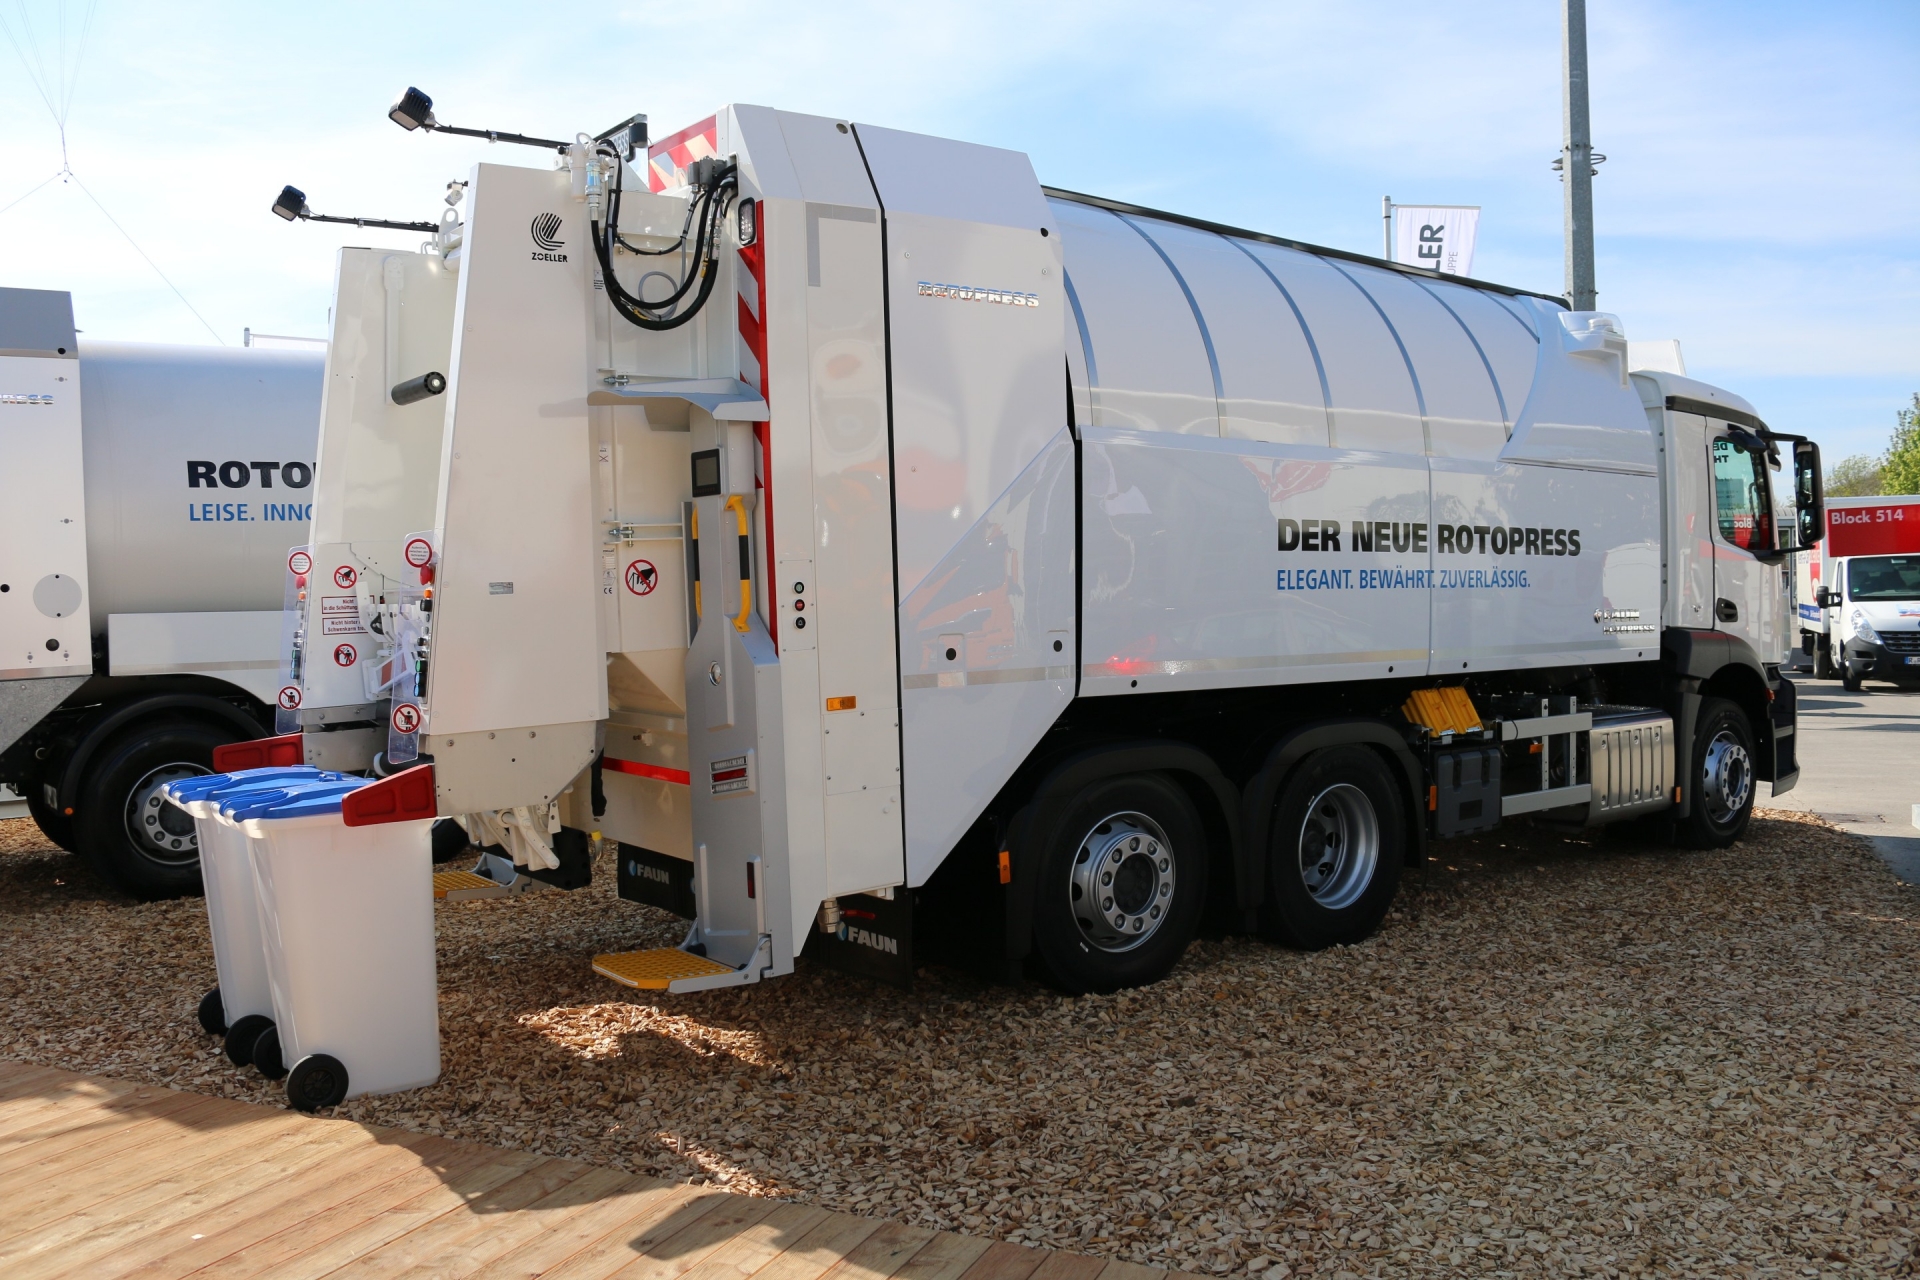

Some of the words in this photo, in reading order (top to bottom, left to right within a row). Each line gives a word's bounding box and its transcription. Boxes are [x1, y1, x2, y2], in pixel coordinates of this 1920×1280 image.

[531, 252, 568, 263] ZOELLER
[917, 281, 1039, 307] ROTOPRESS
[0, 394, 54, 405] RESS
[187, 460, 317, 489] ROTO
[189, 503, 254, 521] LEISE.
[1831, 510, 1871, 525] Block
[1876, 508, 1904, 523] 514
[1277, 518, 1341, 552] DER
[1352, 521, 1428, 553] NEUE
[1437, 523, 1581, 557] ROTOPRESS
[1277, 568, 1354, 590] ELEGANT.
[1359, 565, 1435, 589] BEWÄHRT.
[1440, 565, 1531, 588] ZUVERLÄSSIG.
[636, 863, 670, 885] FAUN
[847, 925, 898, 955] FAUN
